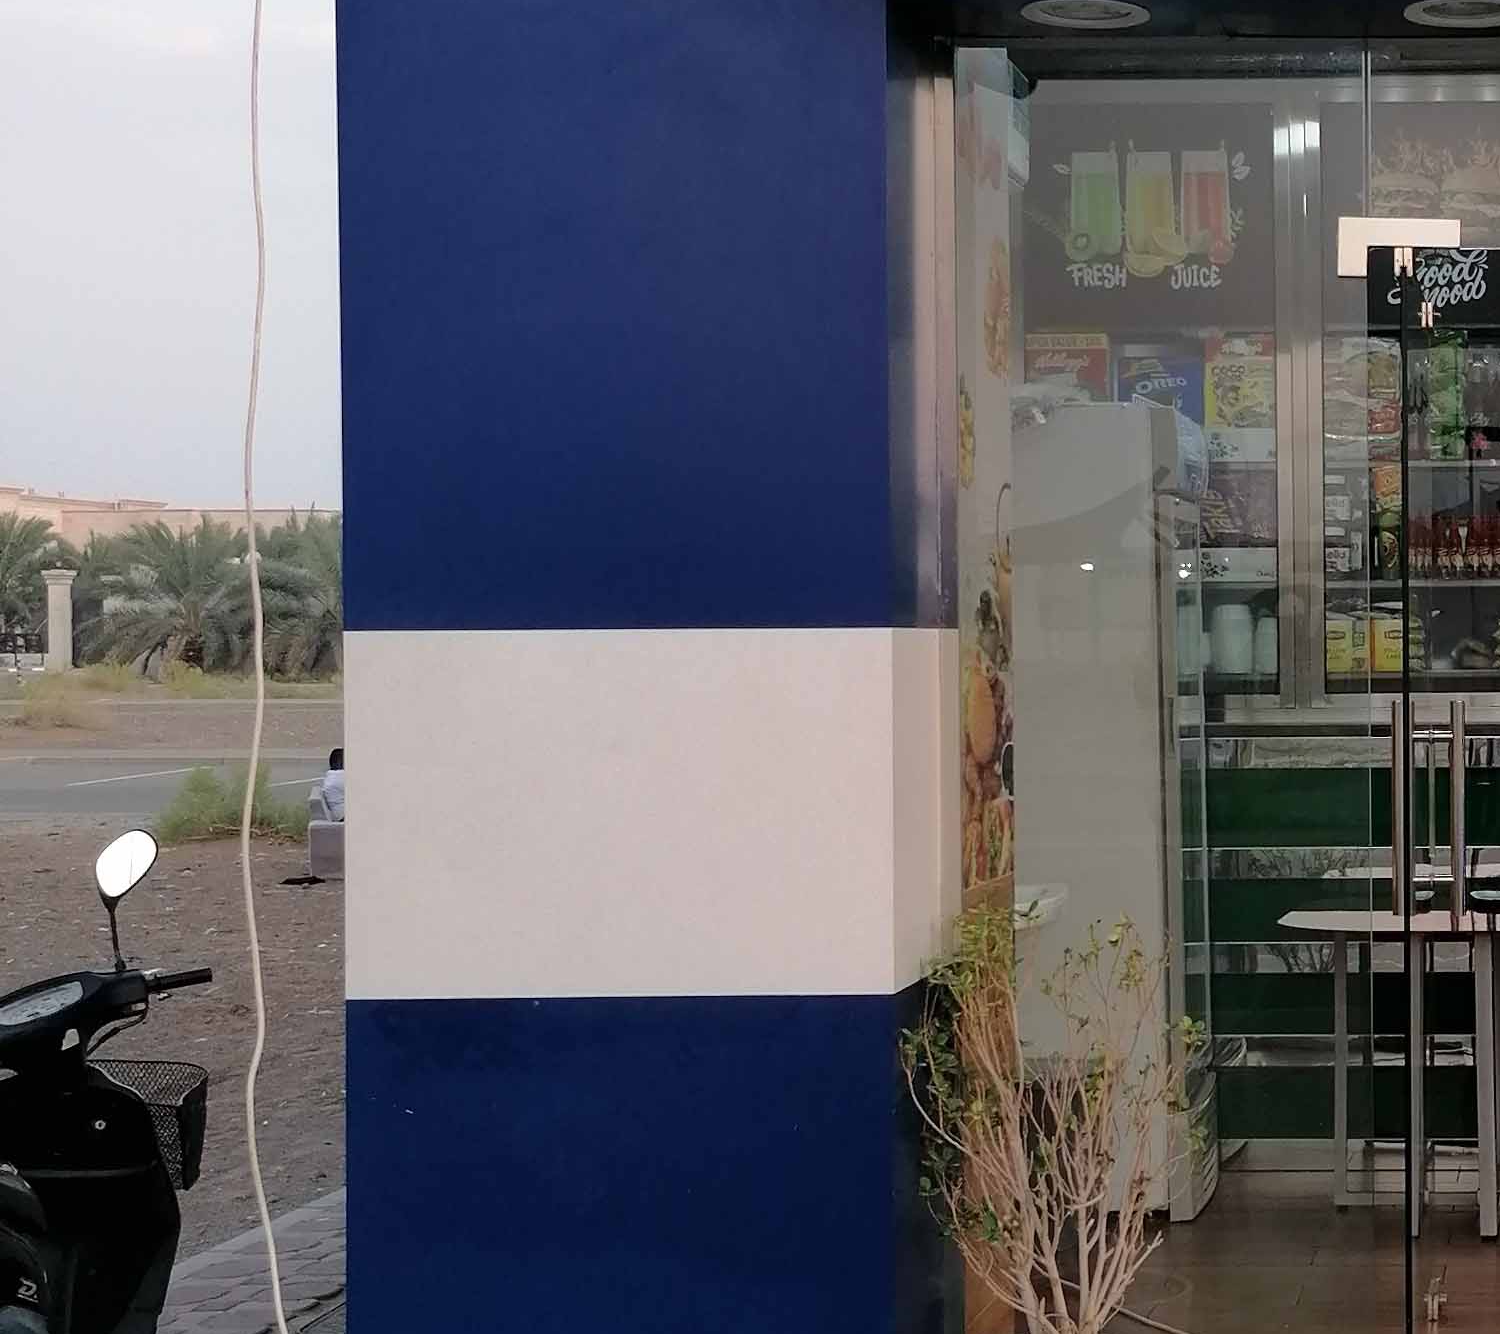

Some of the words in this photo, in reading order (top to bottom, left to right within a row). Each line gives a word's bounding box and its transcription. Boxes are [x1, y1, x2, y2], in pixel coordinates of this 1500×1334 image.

[1065, 263, 1127, 289] FRESH
[1170, 264, 1222, 289] JUICE
[1136, 378, 1187, 394] OREO
